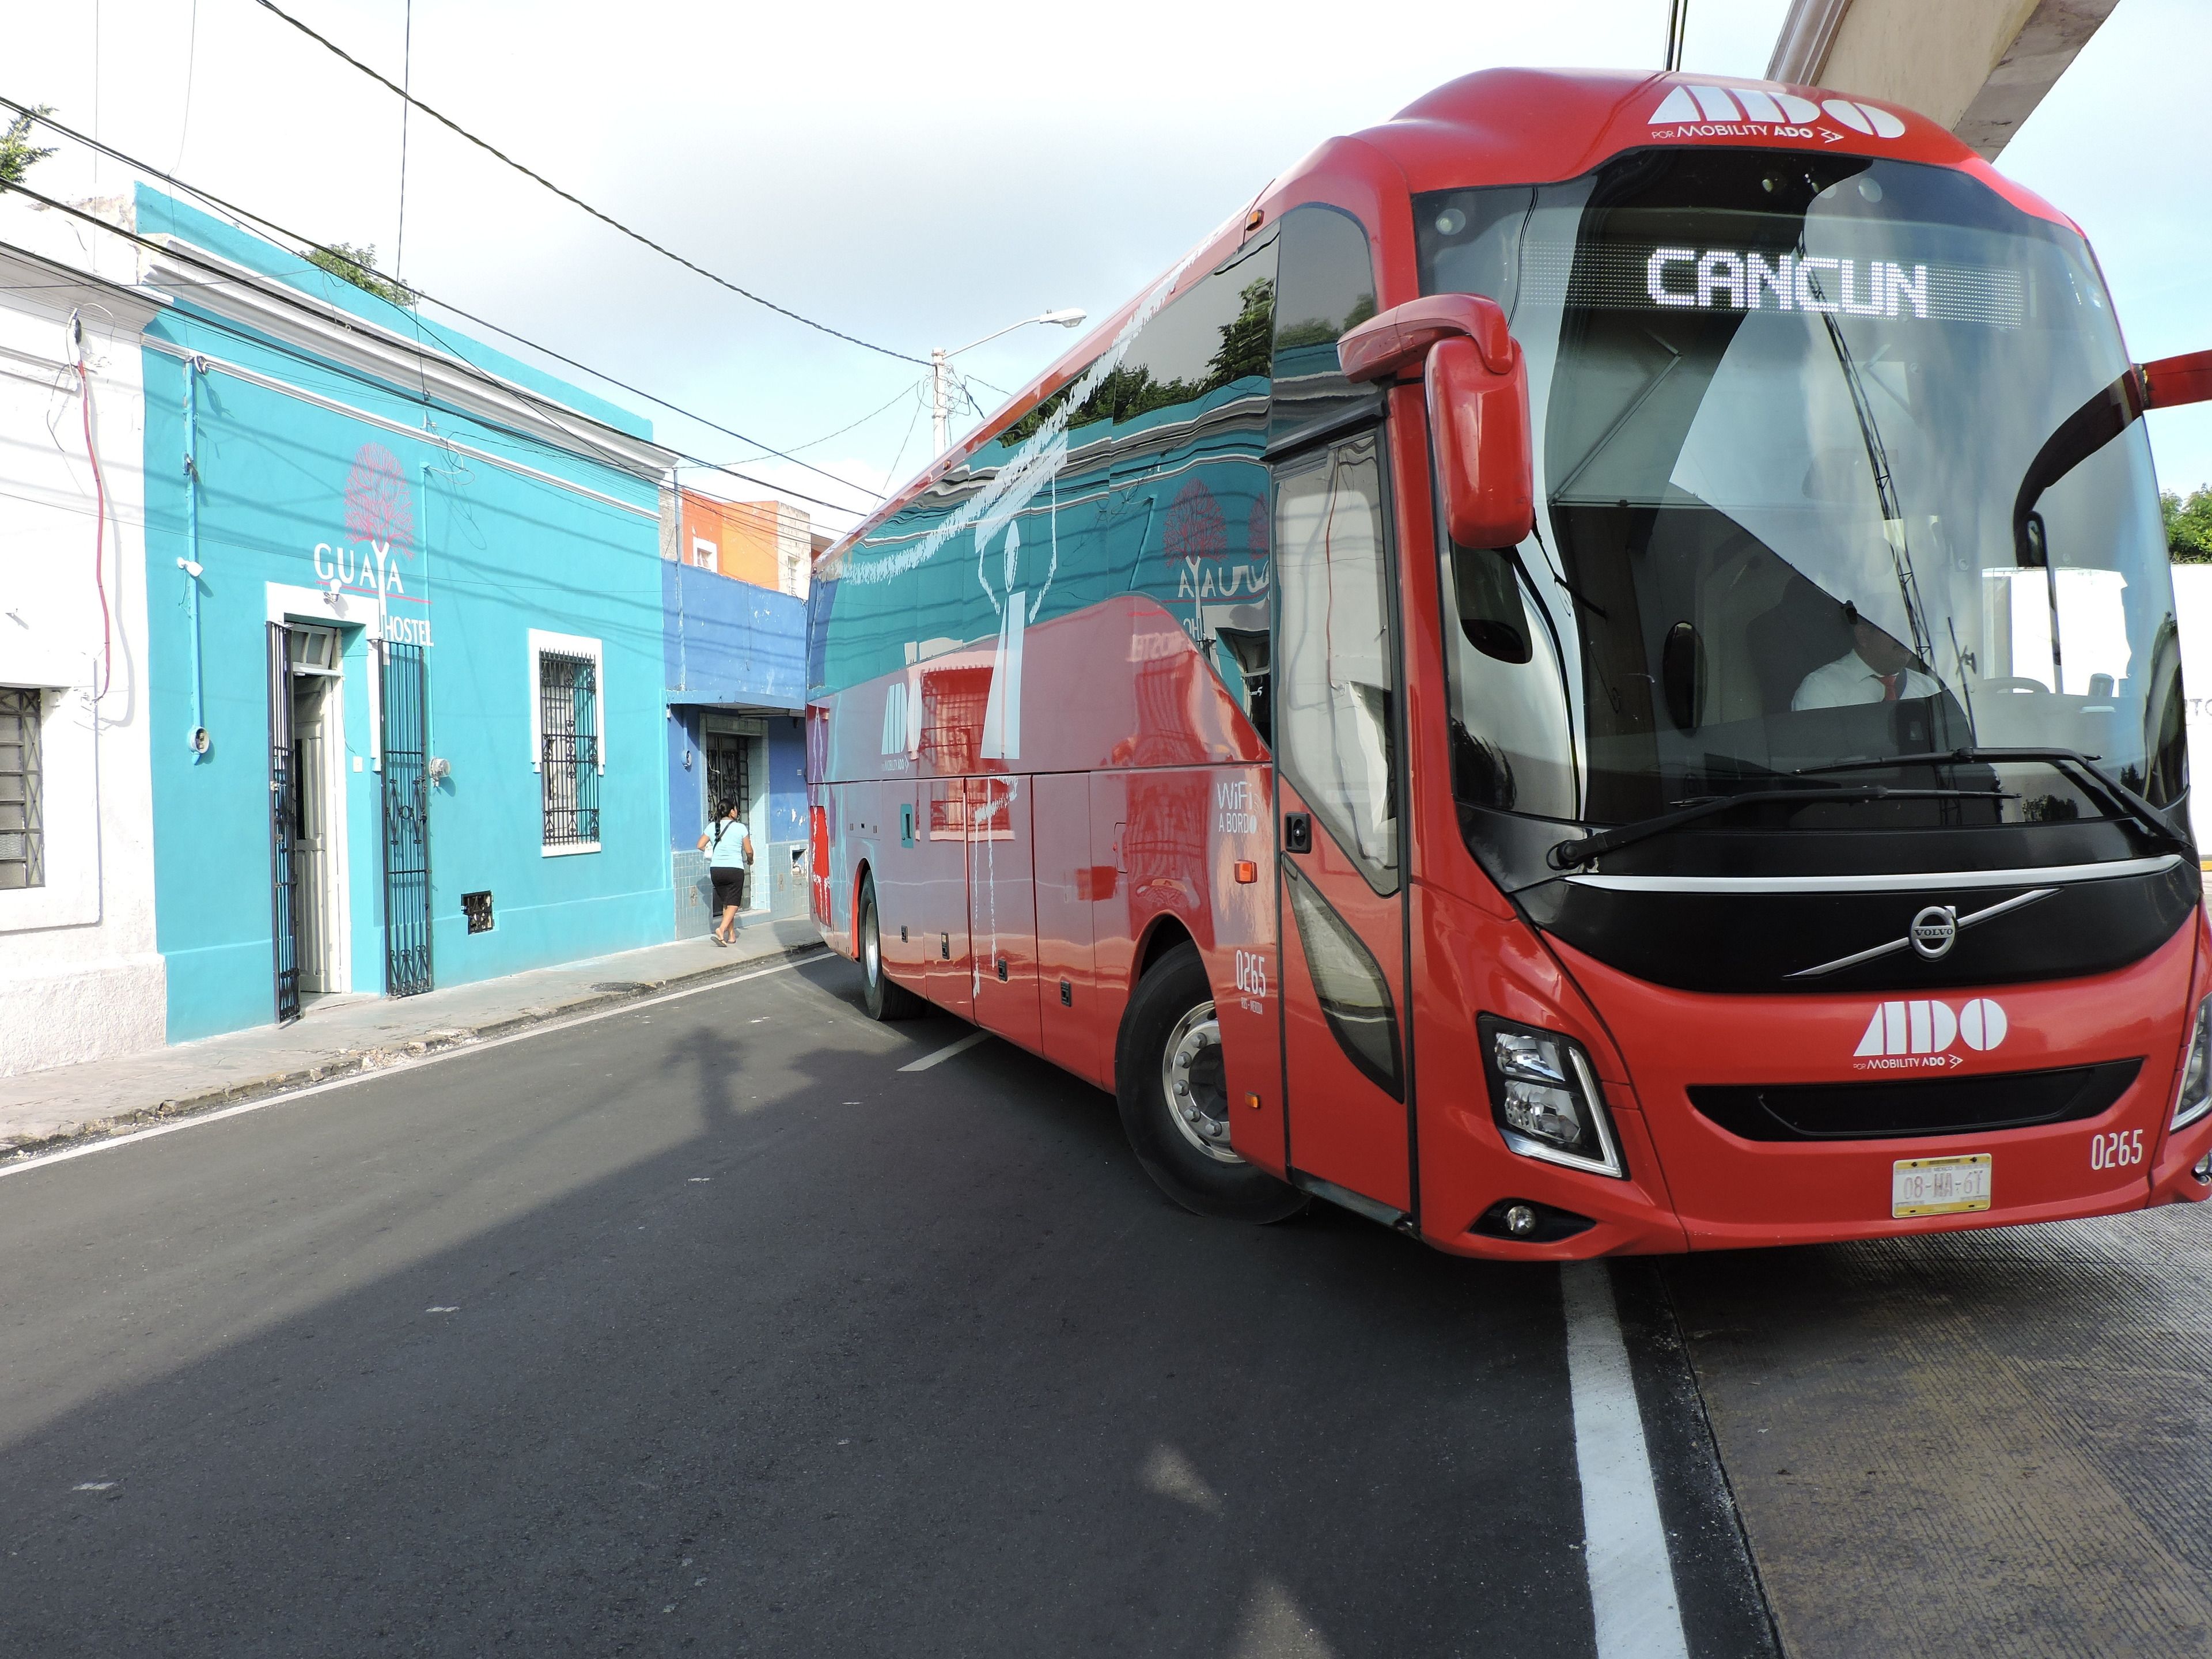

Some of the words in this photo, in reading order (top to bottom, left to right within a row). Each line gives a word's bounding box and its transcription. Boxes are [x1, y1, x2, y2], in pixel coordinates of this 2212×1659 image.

[1647, 85, 1906, 139] ADO
[1652, 130, 1676, 139] POR
[1677, 124, 1768, 138] MOBILITY
[1774, 126, 1813, 139] ADO
[1647, 248, 1927, 319] CANCUN
[313, 539, 404, 602] GUAYA
[383, 614, 434, 647] HOSTEL
[1217, 781, 1252, 810] WiFi
[1218, 813, 1225, 832] A
[1226, 813, 1257, 834] BORDO
[1914, 928, 1953, 936] VOLVO
[1236, 949, 1266, 997] 0265
[1853, 998, 2008, 1057] ADO
[1866, 1058, 1920, 1070] MOBILITY
[1922, 1056, 1945, 1067] ADO
[2090, 1129, 2143, 1171] 0265
